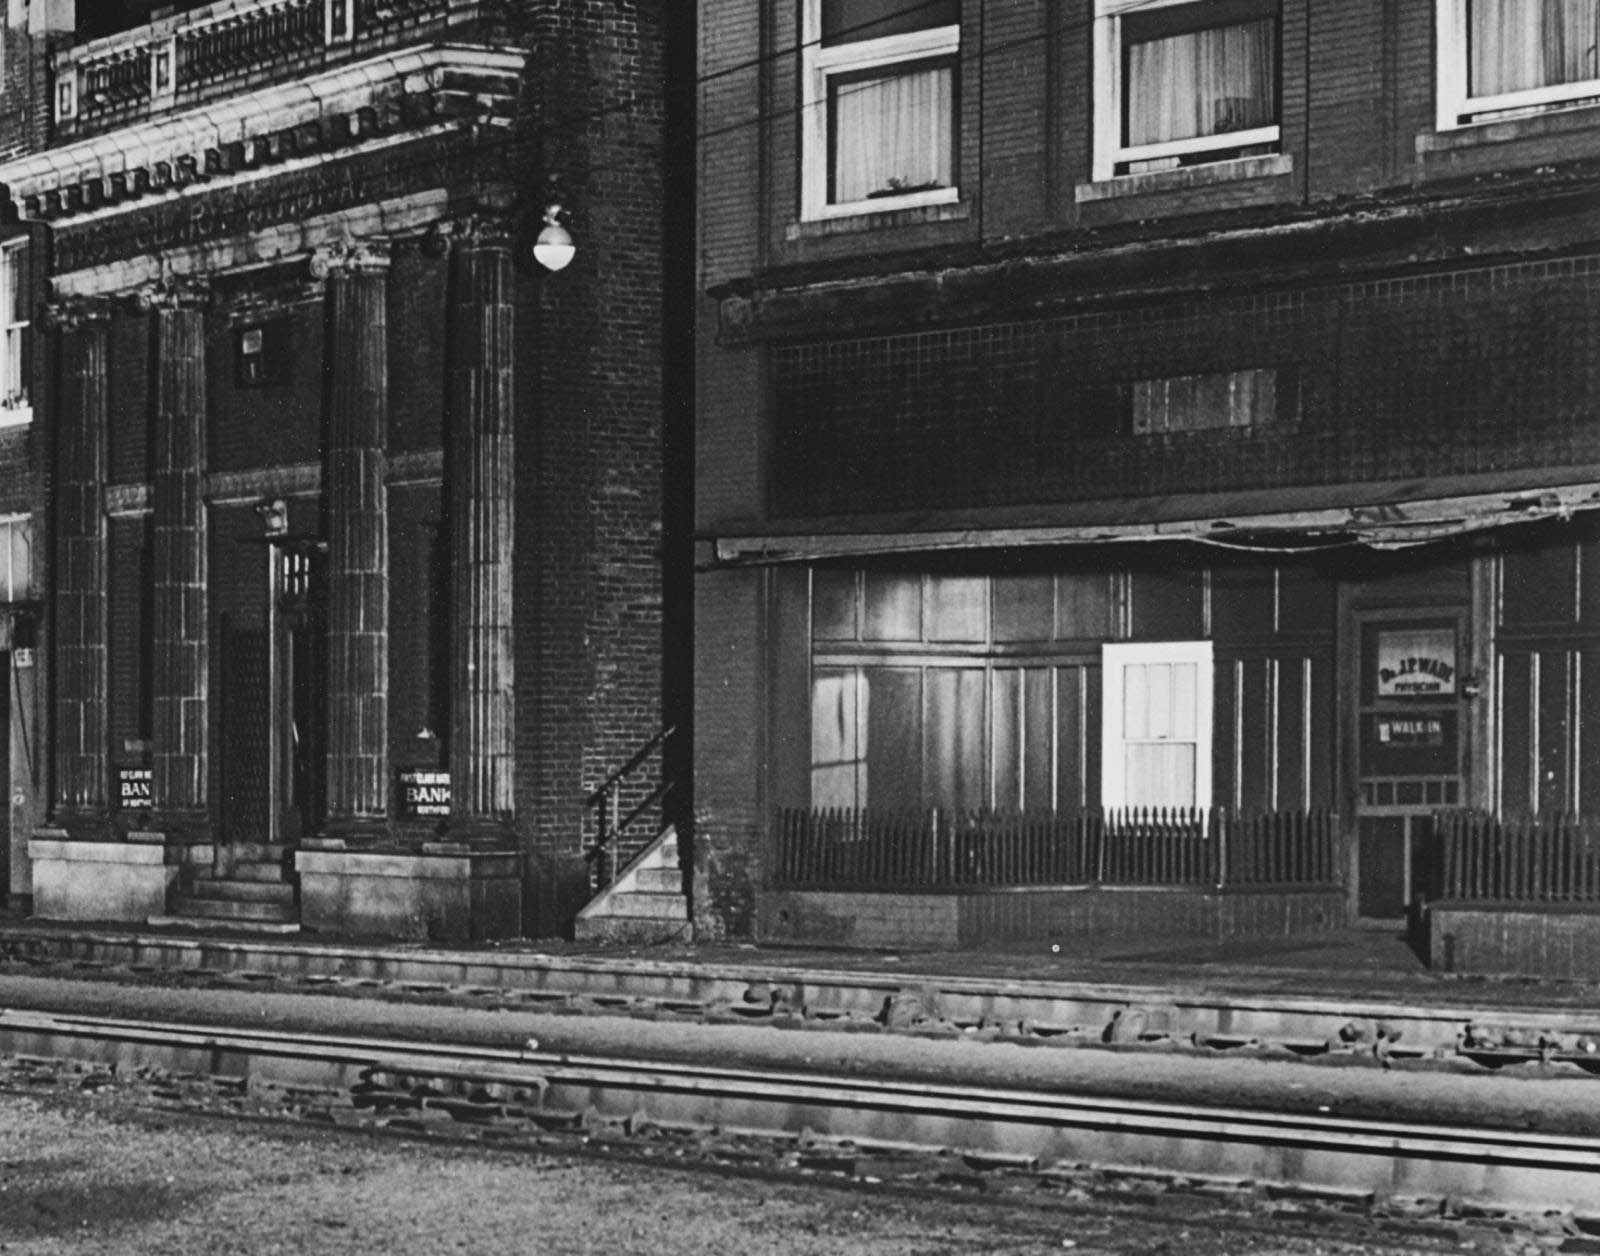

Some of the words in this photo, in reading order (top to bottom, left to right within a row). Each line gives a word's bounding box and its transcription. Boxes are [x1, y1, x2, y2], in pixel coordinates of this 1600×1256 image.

[1392, 720, 1425, 734] WALK
[1427, 720, 1441, 734] IN
[406, 786, 451, 803] BANK
